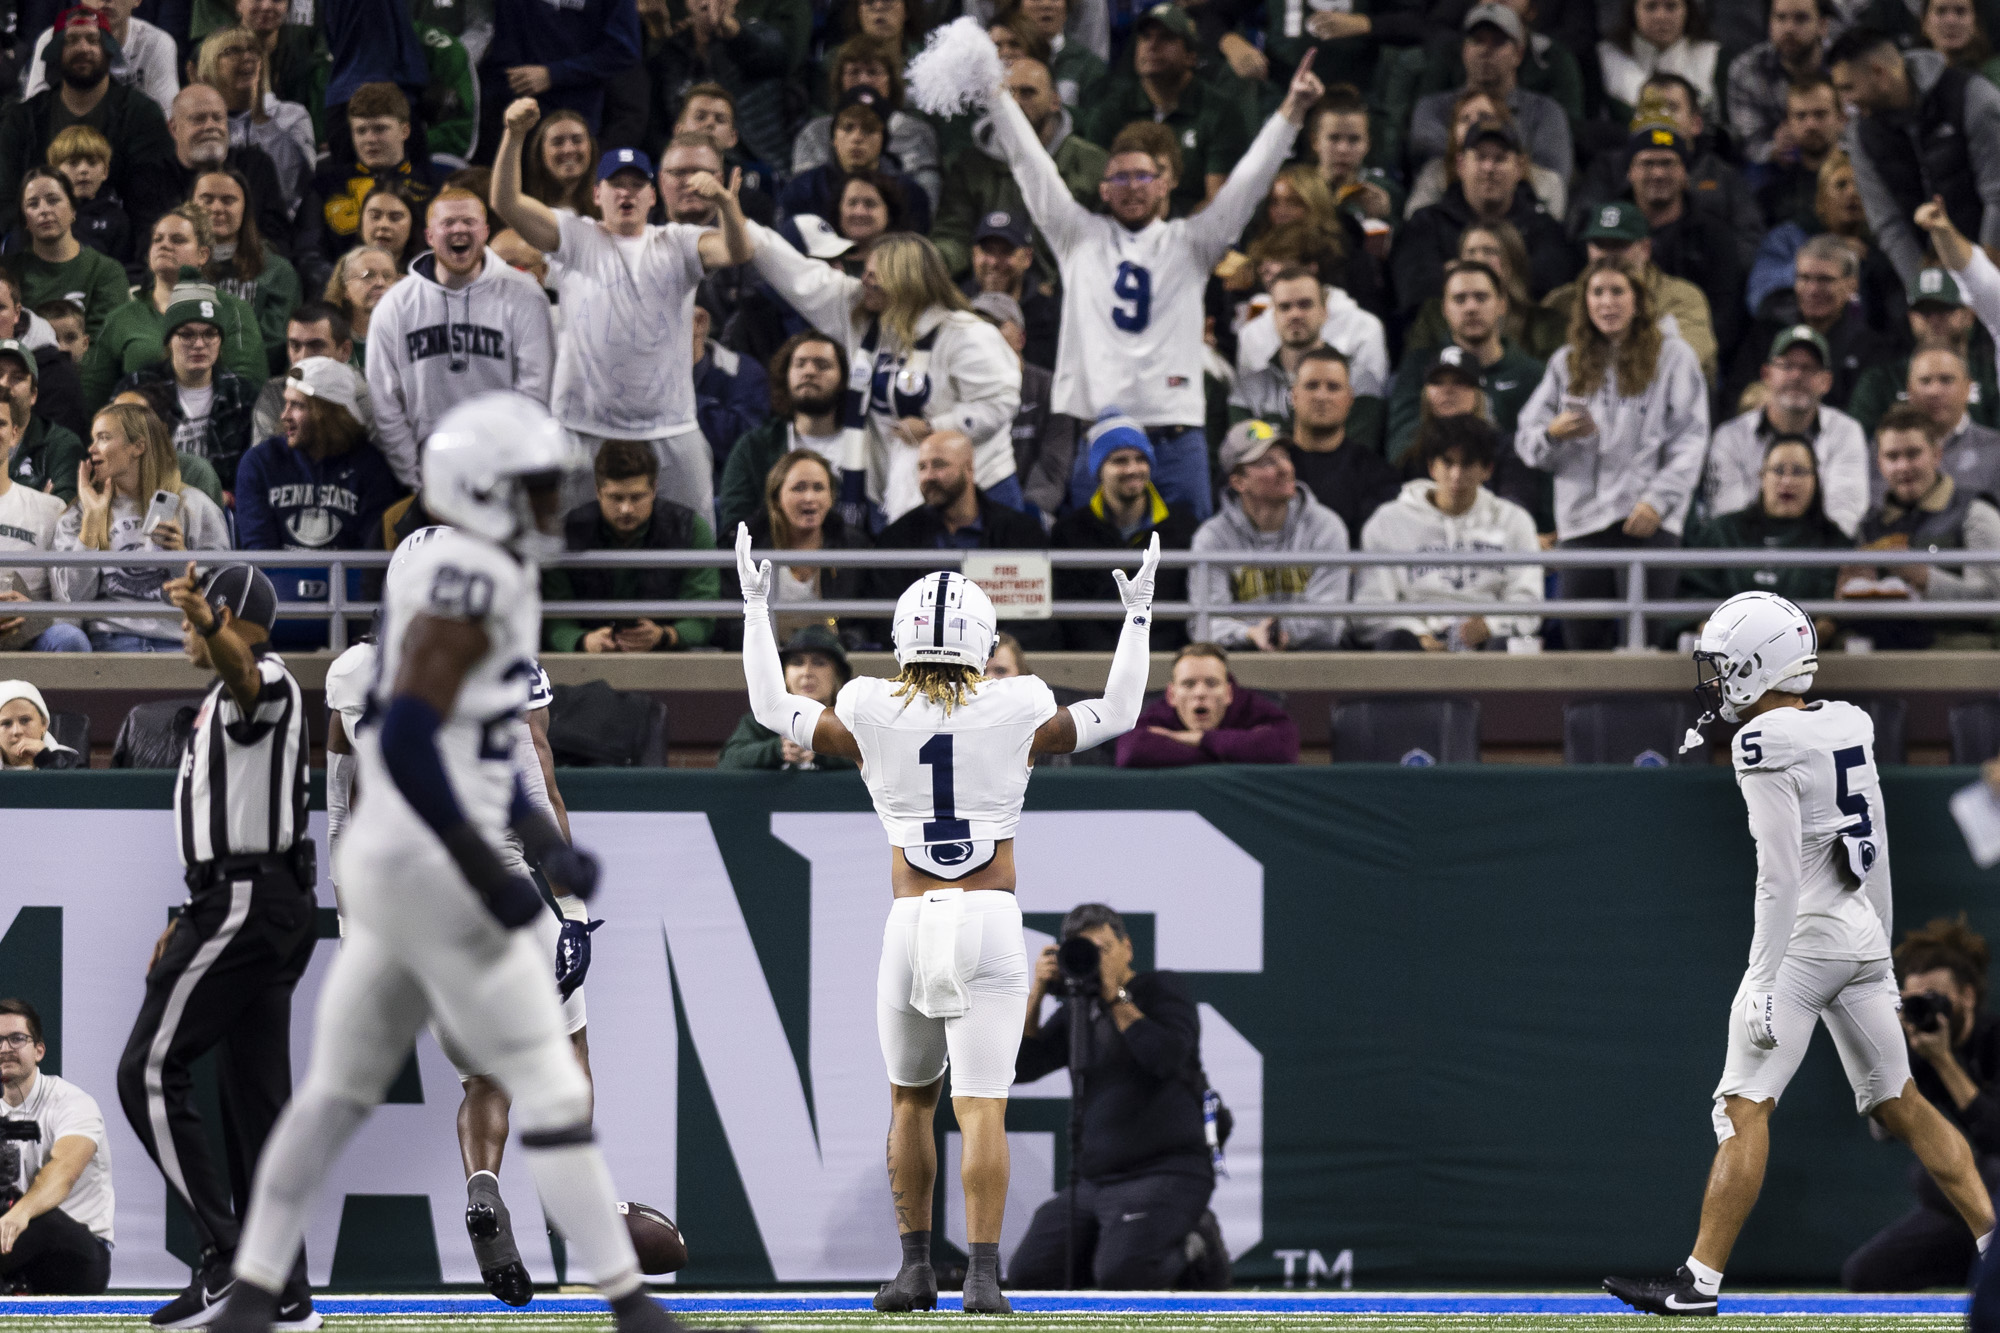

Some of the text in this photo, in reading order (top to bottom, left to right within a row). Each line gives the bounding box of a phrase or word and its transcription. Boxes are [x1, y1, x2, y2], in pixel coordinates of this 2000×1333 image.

[200, 300, 215, 319] S
[1111, 260, 1152, 335] 9
[406, 323, 505, 363] PENN STATE
[269, 484, 359, 516] PENN STATE
[973, 580, 1044, 590] EPARTMENT
[994, 566, 1018, 576] FIRE
[1740, 730, 1763, 766] 5
[919, 733, 971, 843] 1
[1832, 744, 1873, 836] 5
[1273, 1249, 1353, 1290] TM
